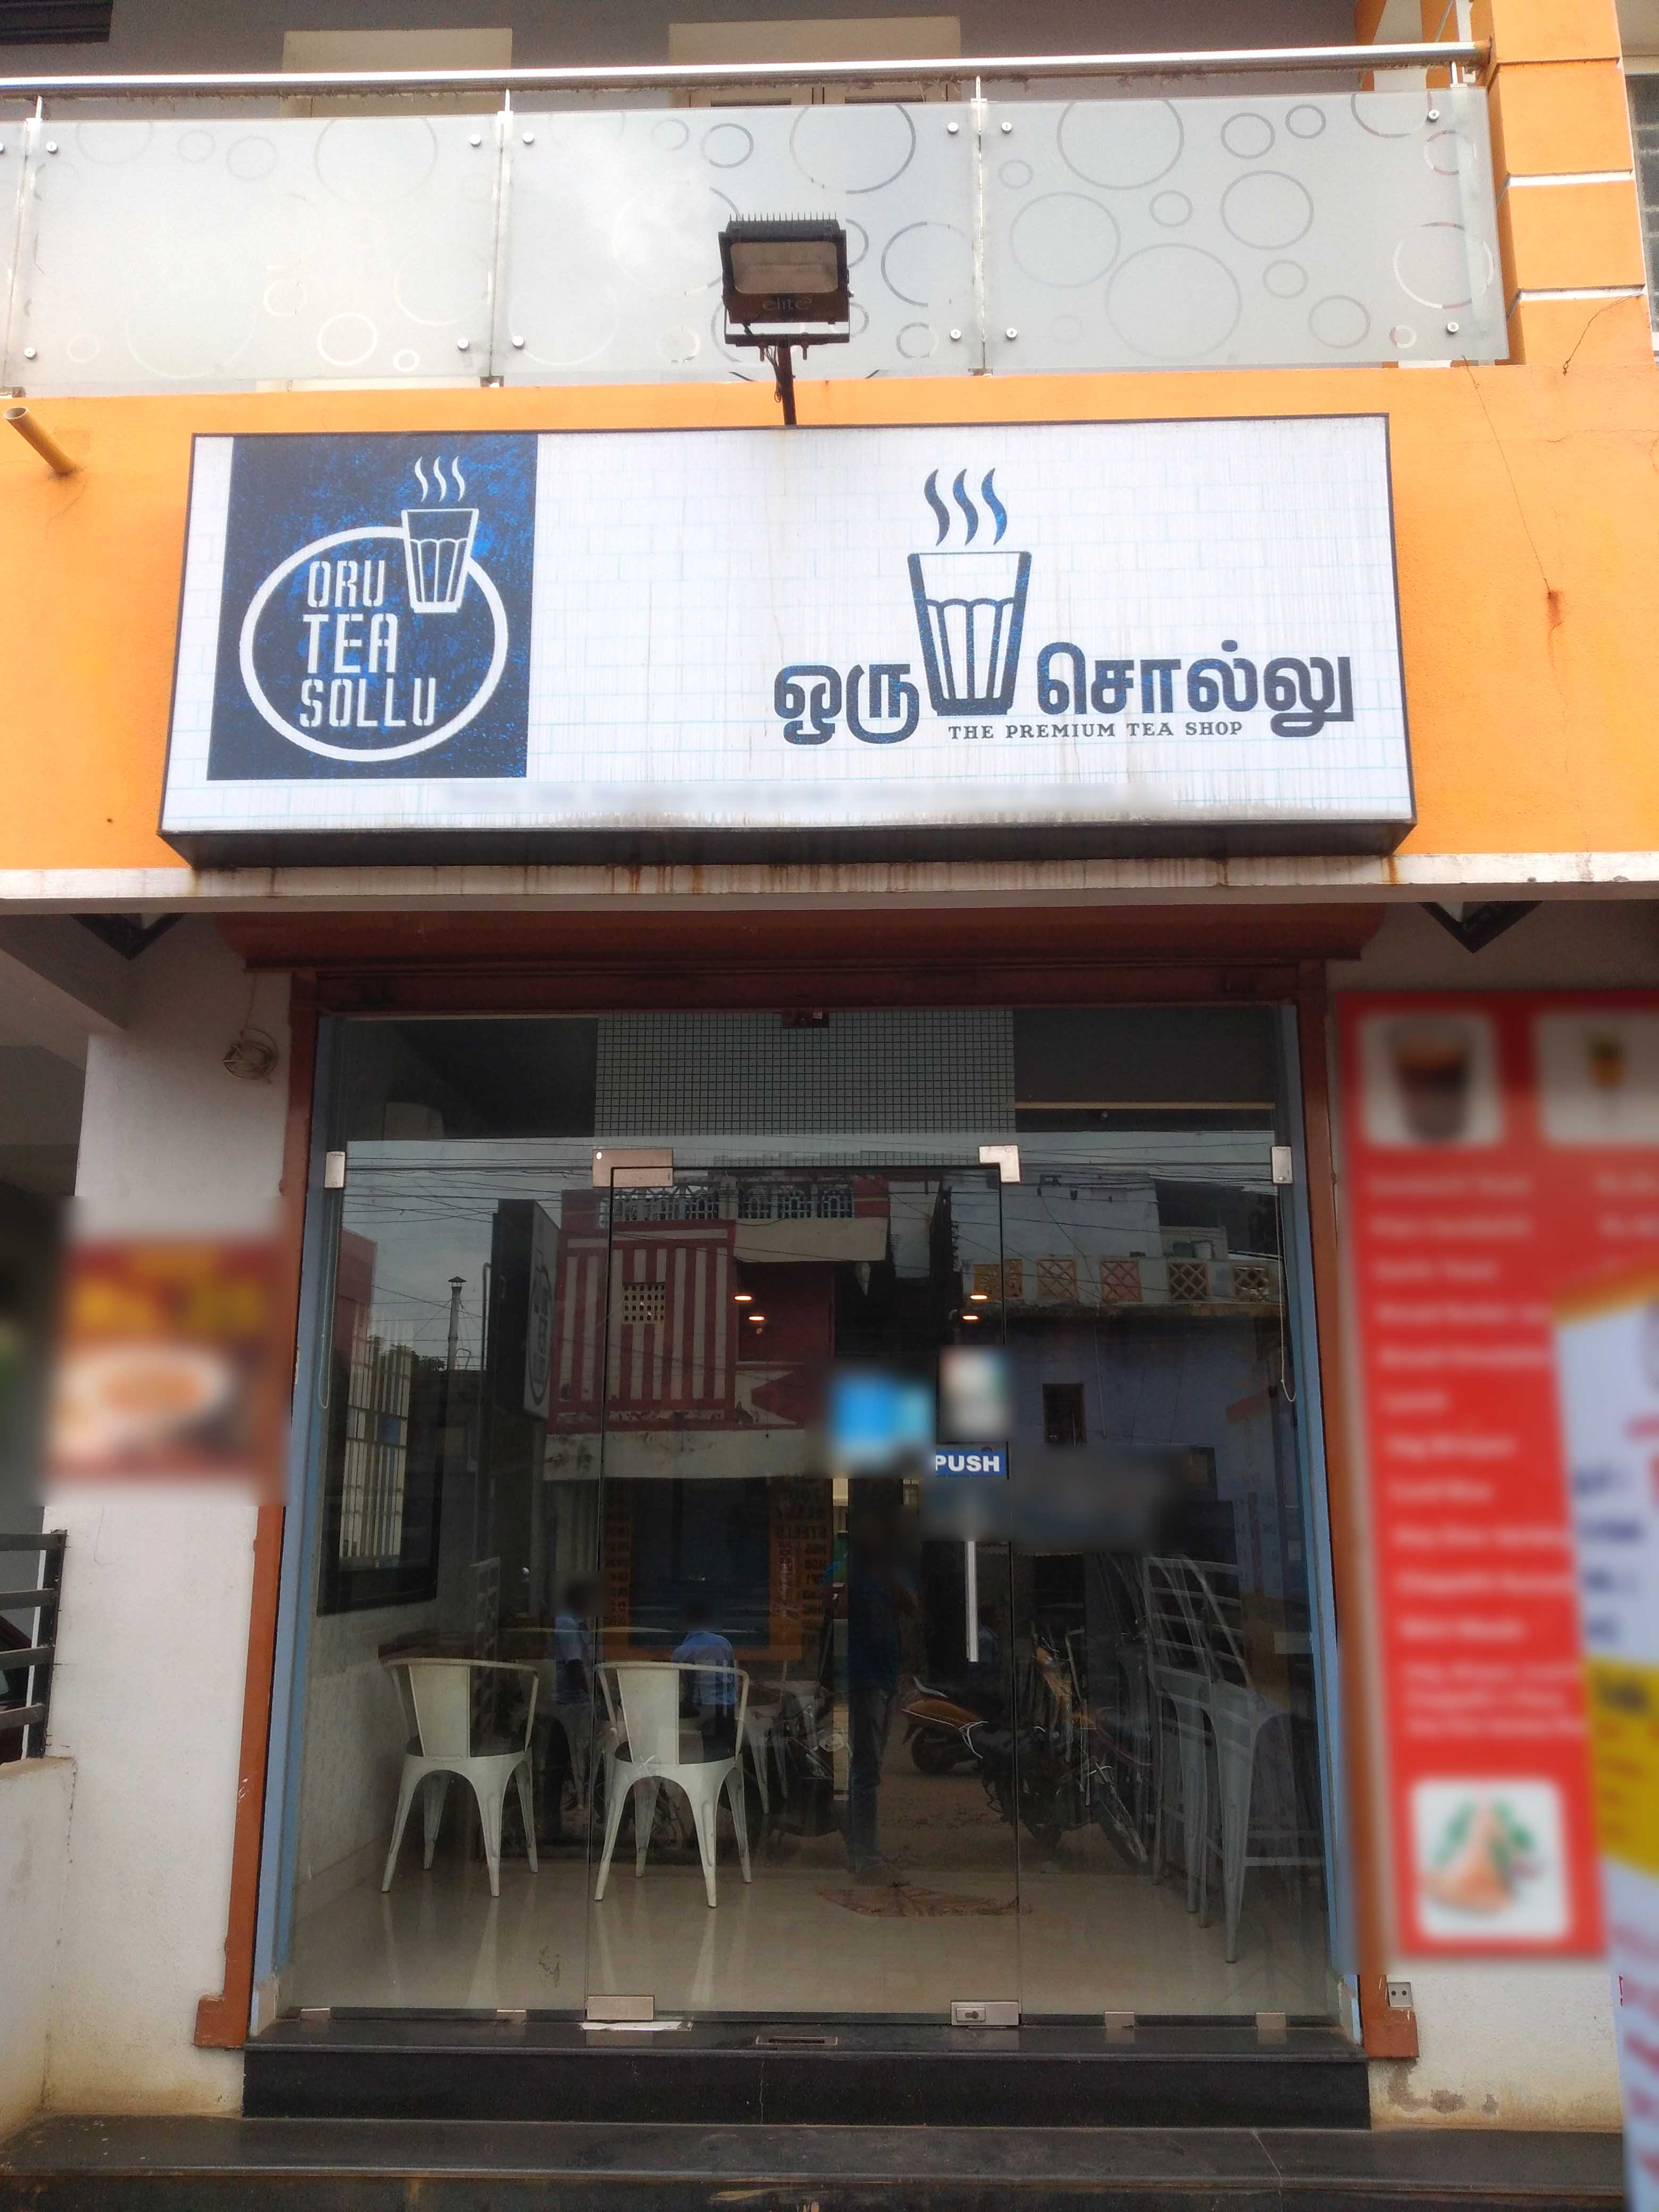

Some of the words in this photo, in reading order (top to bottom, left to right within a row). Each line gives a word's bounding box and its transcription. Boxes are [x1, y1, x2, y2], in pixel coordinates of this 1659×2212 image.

[307, 560, 385, 607] ORU
[303, 613, 398, 674] TEA
[299, 677, 436, 727] SOLLU
[774, 664, 919, 744] ஒரு
[1037, 640, 1354, 738] சொல்லு
[948, 725, 994, 740] THE
[1006, 724, 1116, 739] PREMIUM
[1126, 722, 1174, 736] TEA
[1185, 721, 1242, 735] SHOP
[935, 1454, 1000, 1472] PUSH
